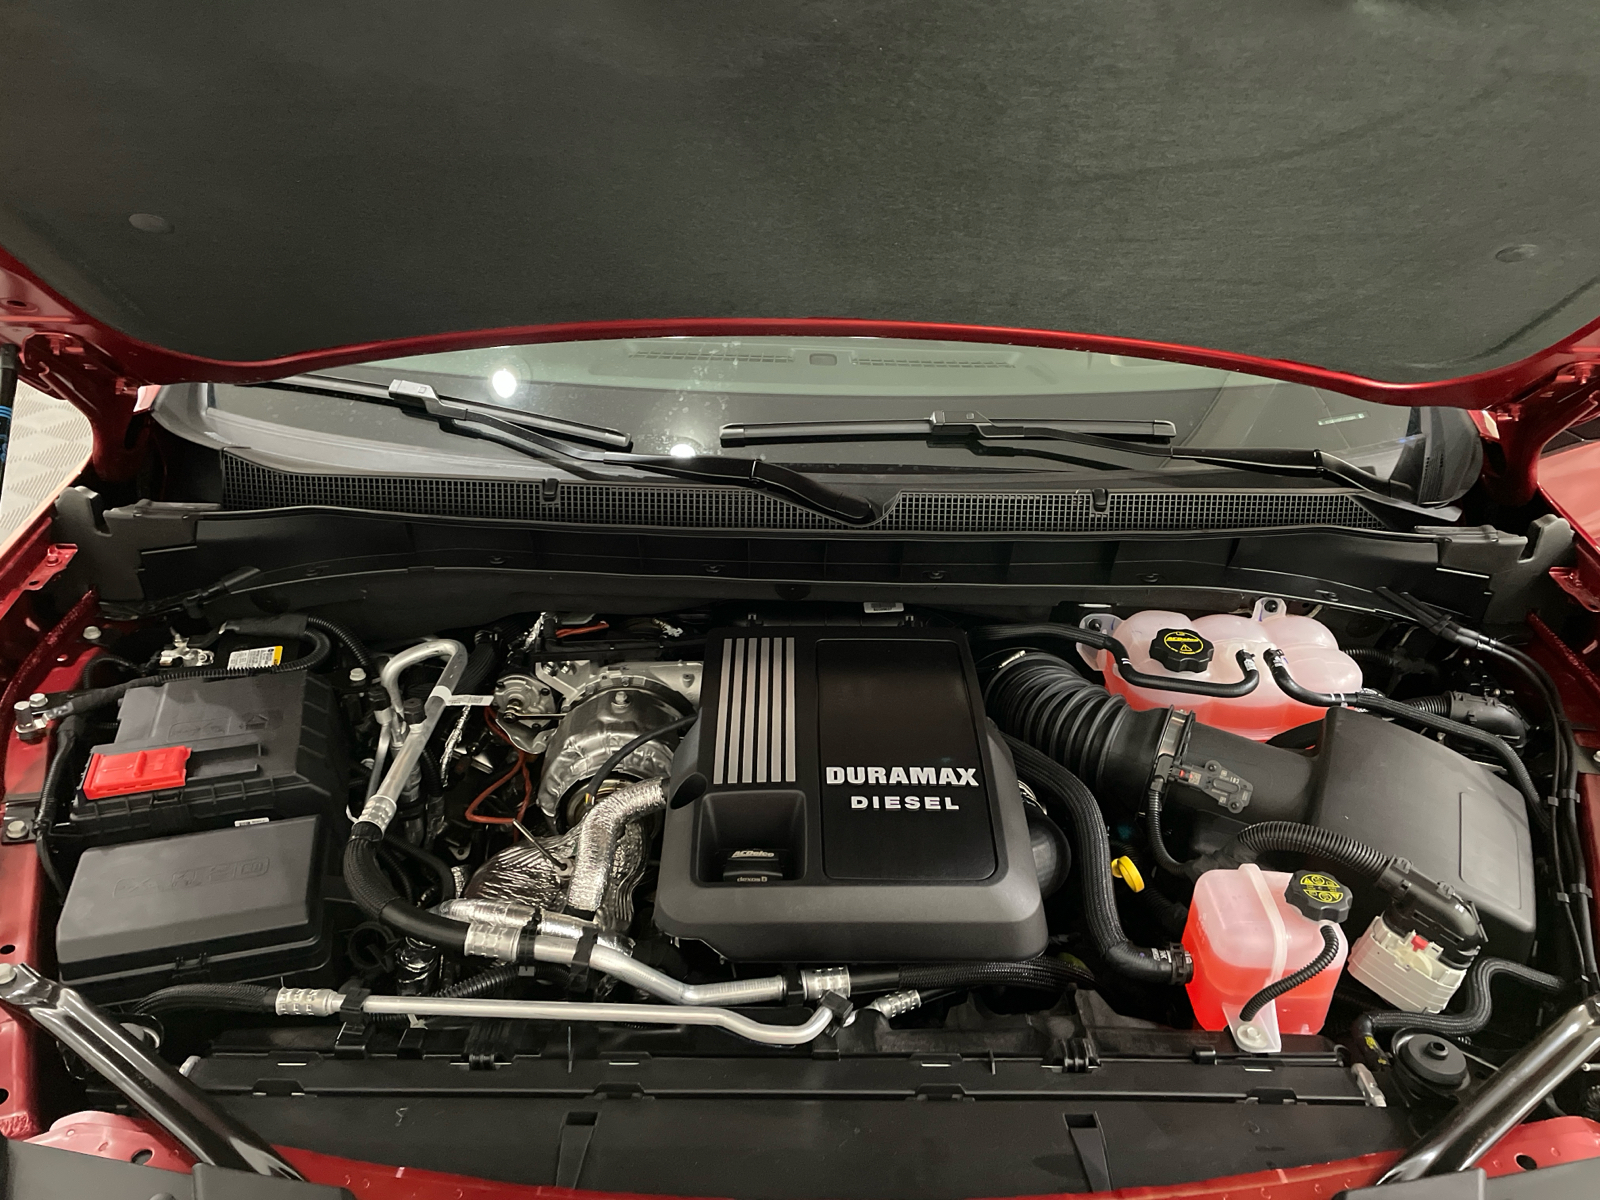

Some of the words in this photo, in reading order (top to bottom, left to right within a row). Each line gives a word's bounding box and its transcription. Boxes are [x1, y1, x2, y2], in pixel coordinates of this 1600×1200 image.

[825, 766, 979, 787] DURAMAX
[851, 795, 960, 811] DIESEL
[731, 850, 775, 858] ACDelco
